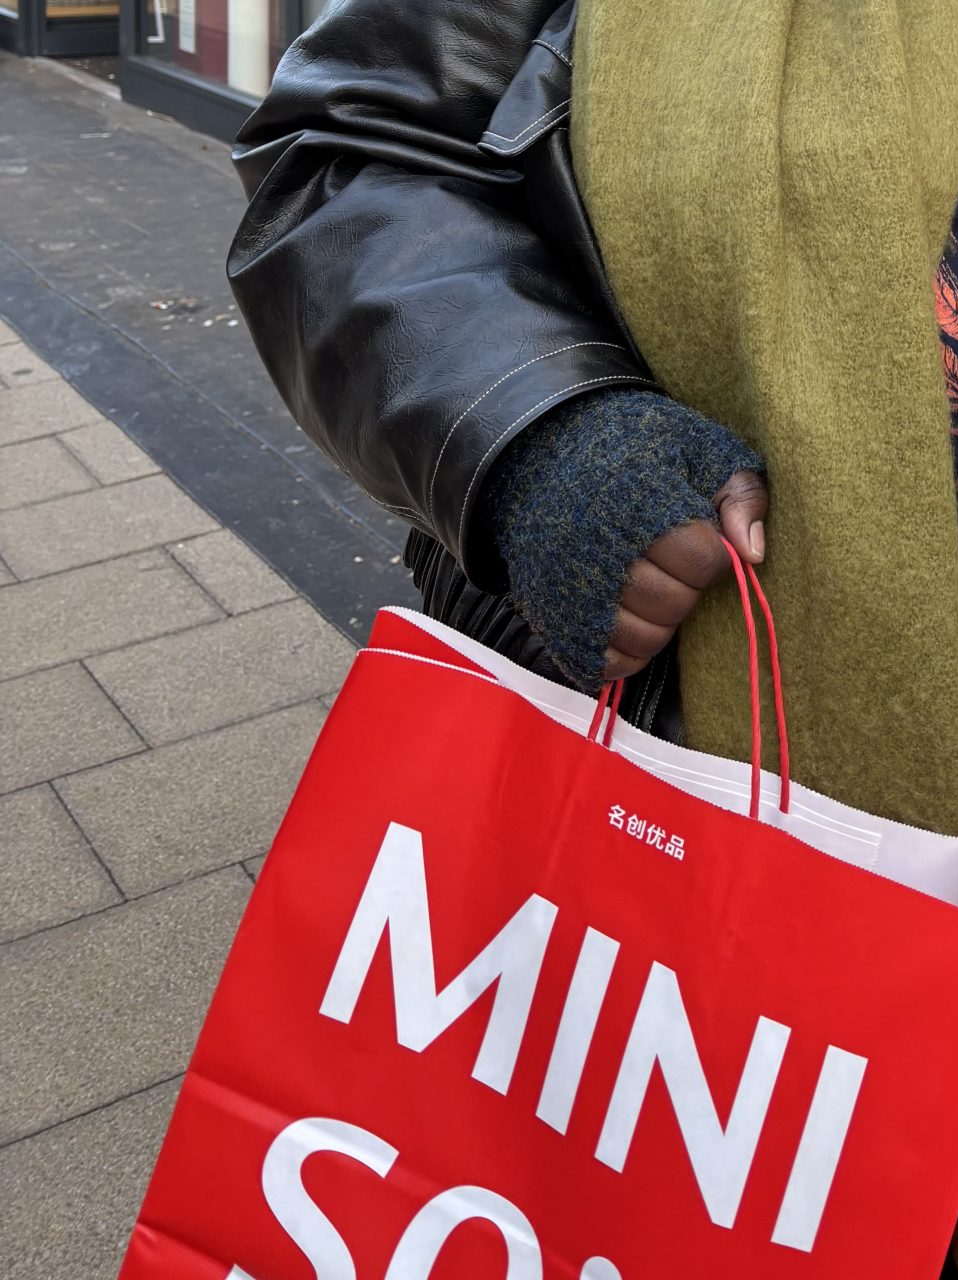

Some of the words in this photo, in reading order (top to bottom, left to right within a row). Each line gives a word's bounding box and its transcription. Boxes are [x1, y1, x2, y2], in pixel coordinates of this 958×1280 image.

[607, 803, 687, 862] 名创优品
[319, 820, 869, 1254] MINI
